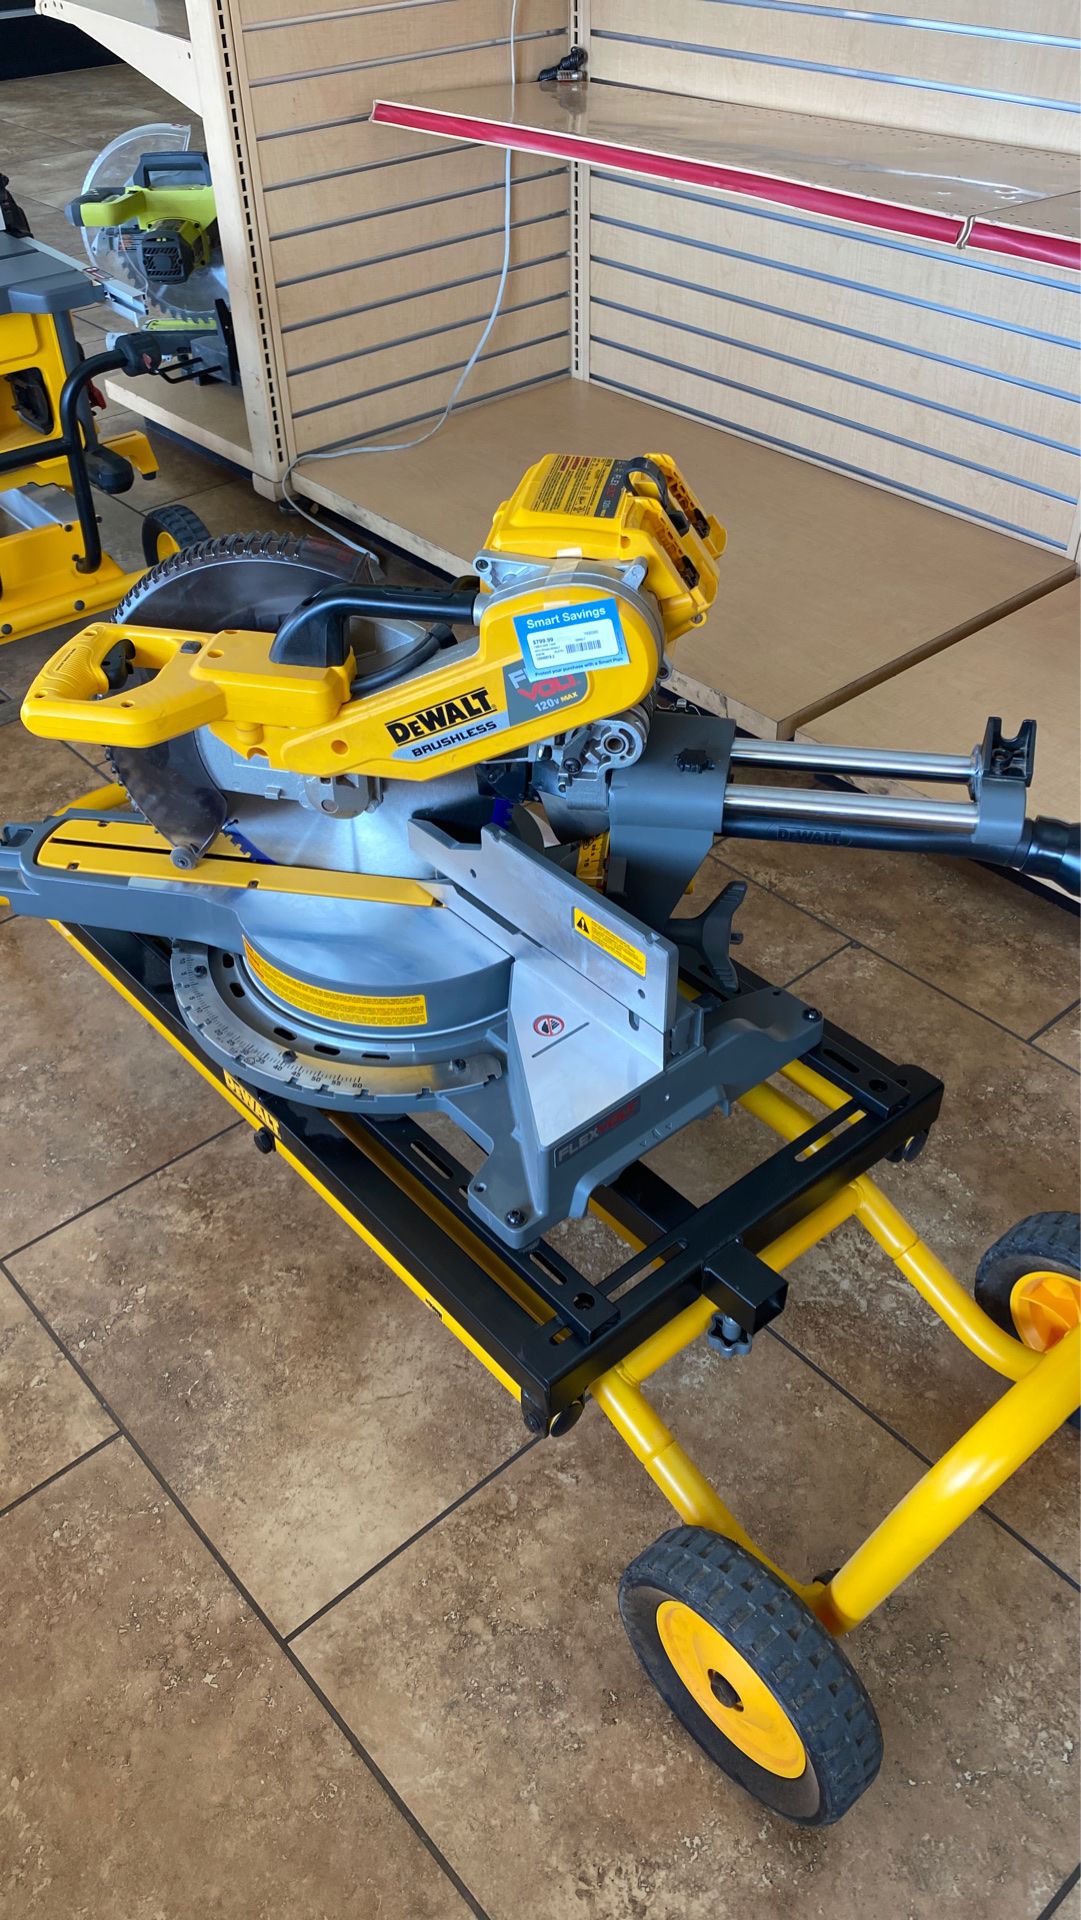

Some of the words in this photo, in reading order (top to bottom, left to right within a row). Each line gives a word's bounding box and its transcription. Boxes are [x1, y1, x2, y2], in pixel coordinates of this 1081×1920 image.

[526, 614, 560, 629] Smart
[561, 607, 606, 622] Savings
[560, 691, 578, 702] MAX
[412, 721, 497, 757] BRUSHLESS
